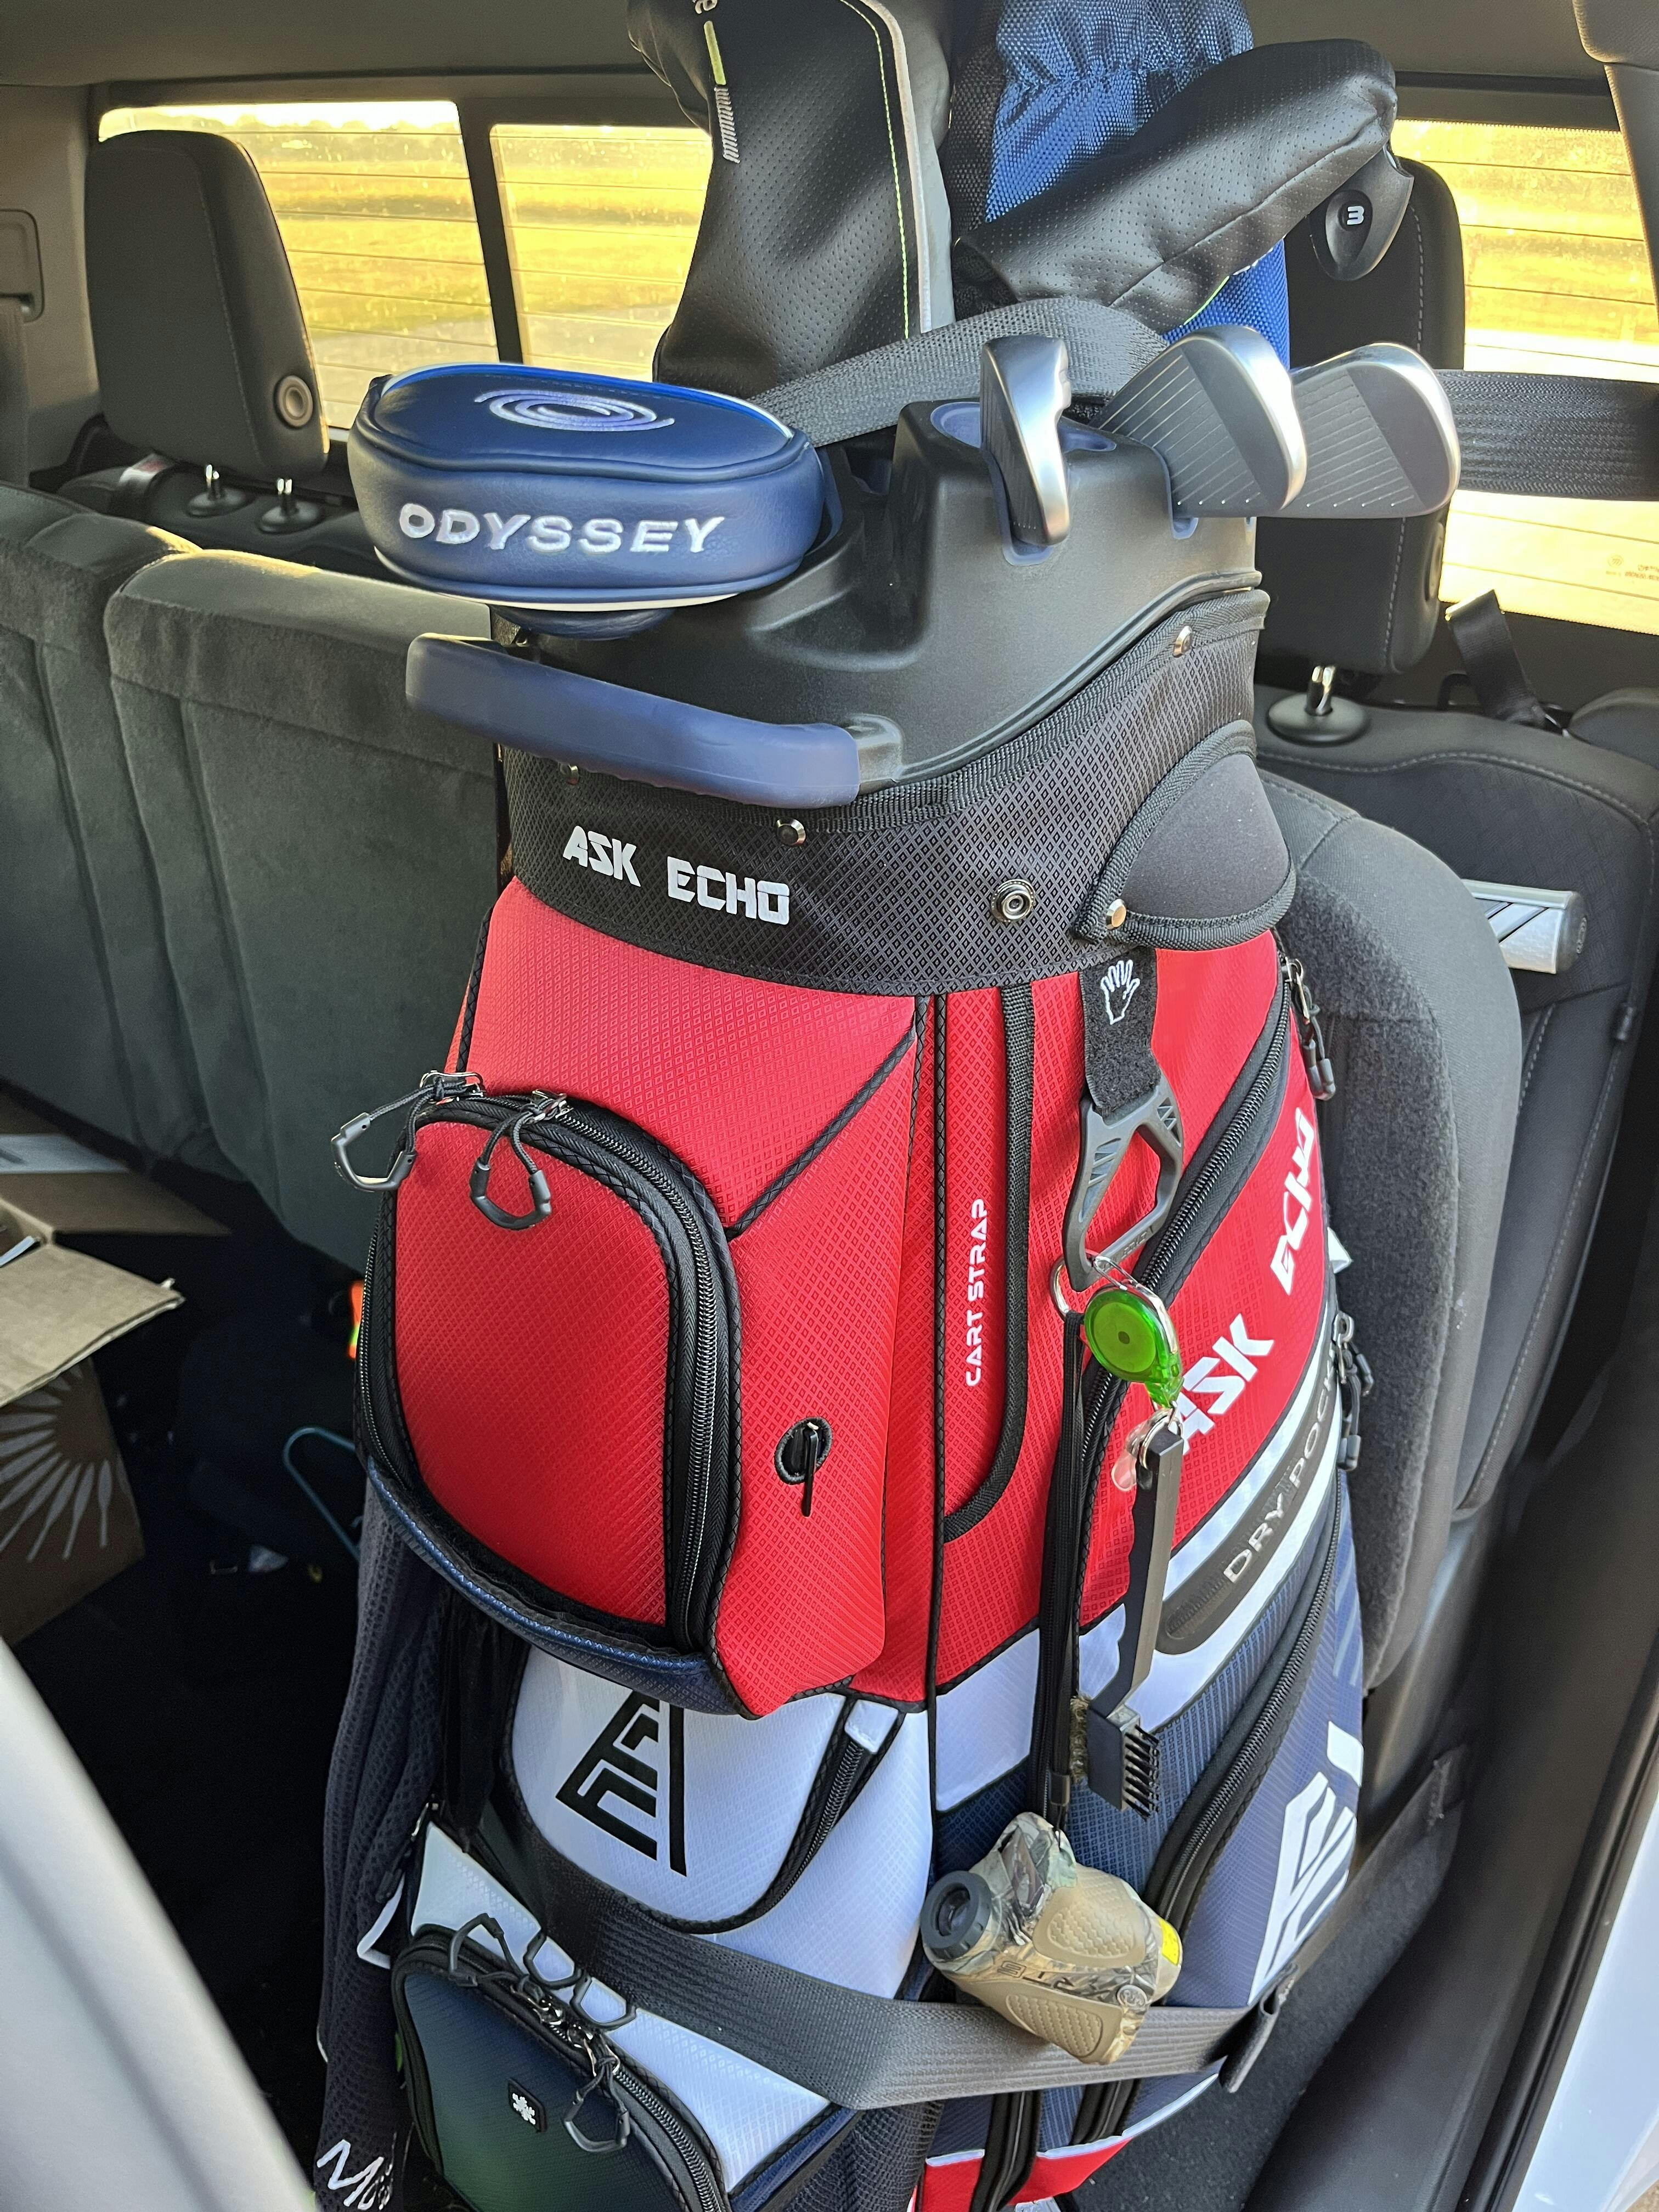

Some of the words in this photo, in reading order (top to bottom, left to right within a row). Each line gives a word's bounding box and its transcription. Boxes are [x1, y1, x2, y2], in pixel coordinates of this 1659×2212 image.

[1346, 205, 1365, 225] 3
[399, 503, 725, 554] ODYSSEY
[562, 825, 641, 887] ASK
[667, 856, 790, 926] ECHO
[967, 1198, 988, 1302] STRAP
[1169, 1312, 1275, 1456] ASK
[1269, 1107, 1315, 1295] ECHO
[966, 1309, 983, 1387] CART
[1223, 1492, 1284, 1583] DRY
